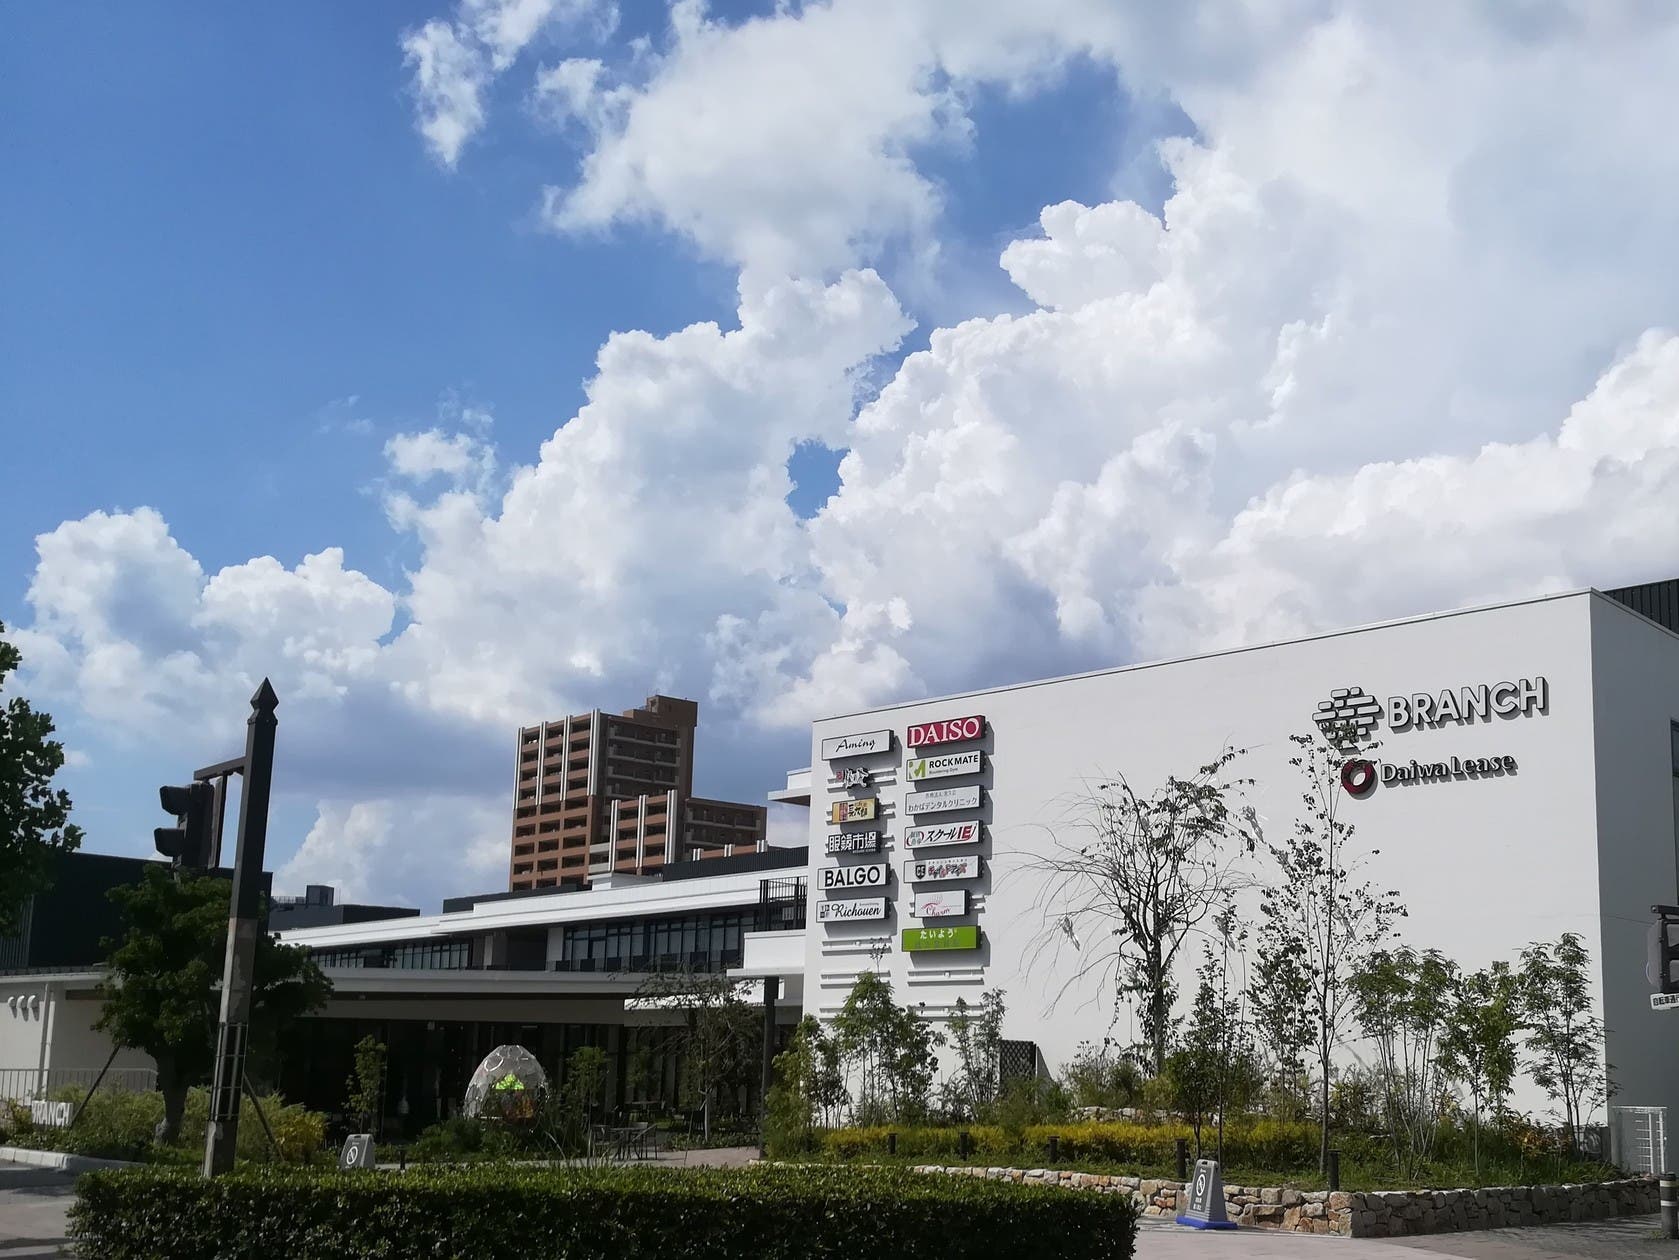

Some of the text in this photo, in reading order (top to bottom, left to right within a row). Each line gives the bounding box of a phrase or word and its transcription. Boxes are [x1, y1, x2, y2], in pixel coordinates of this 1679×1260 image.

[1388, 677, 1546, 728] BRANCH
[909, 717, 980, 746] DAISO
[835, 738, 877, 753] Aming
[1380, 753, 1516, 783] Daiwa Lease
[908, 796, 977, 812] わかばデンタルクリニック
[829, 831, 877, 852] 眼鏡市場
[824, 866, 880, 887] BALGO
[831, 903, 881, 918] Richouen
[920, 928, 954, 939] たいよう
